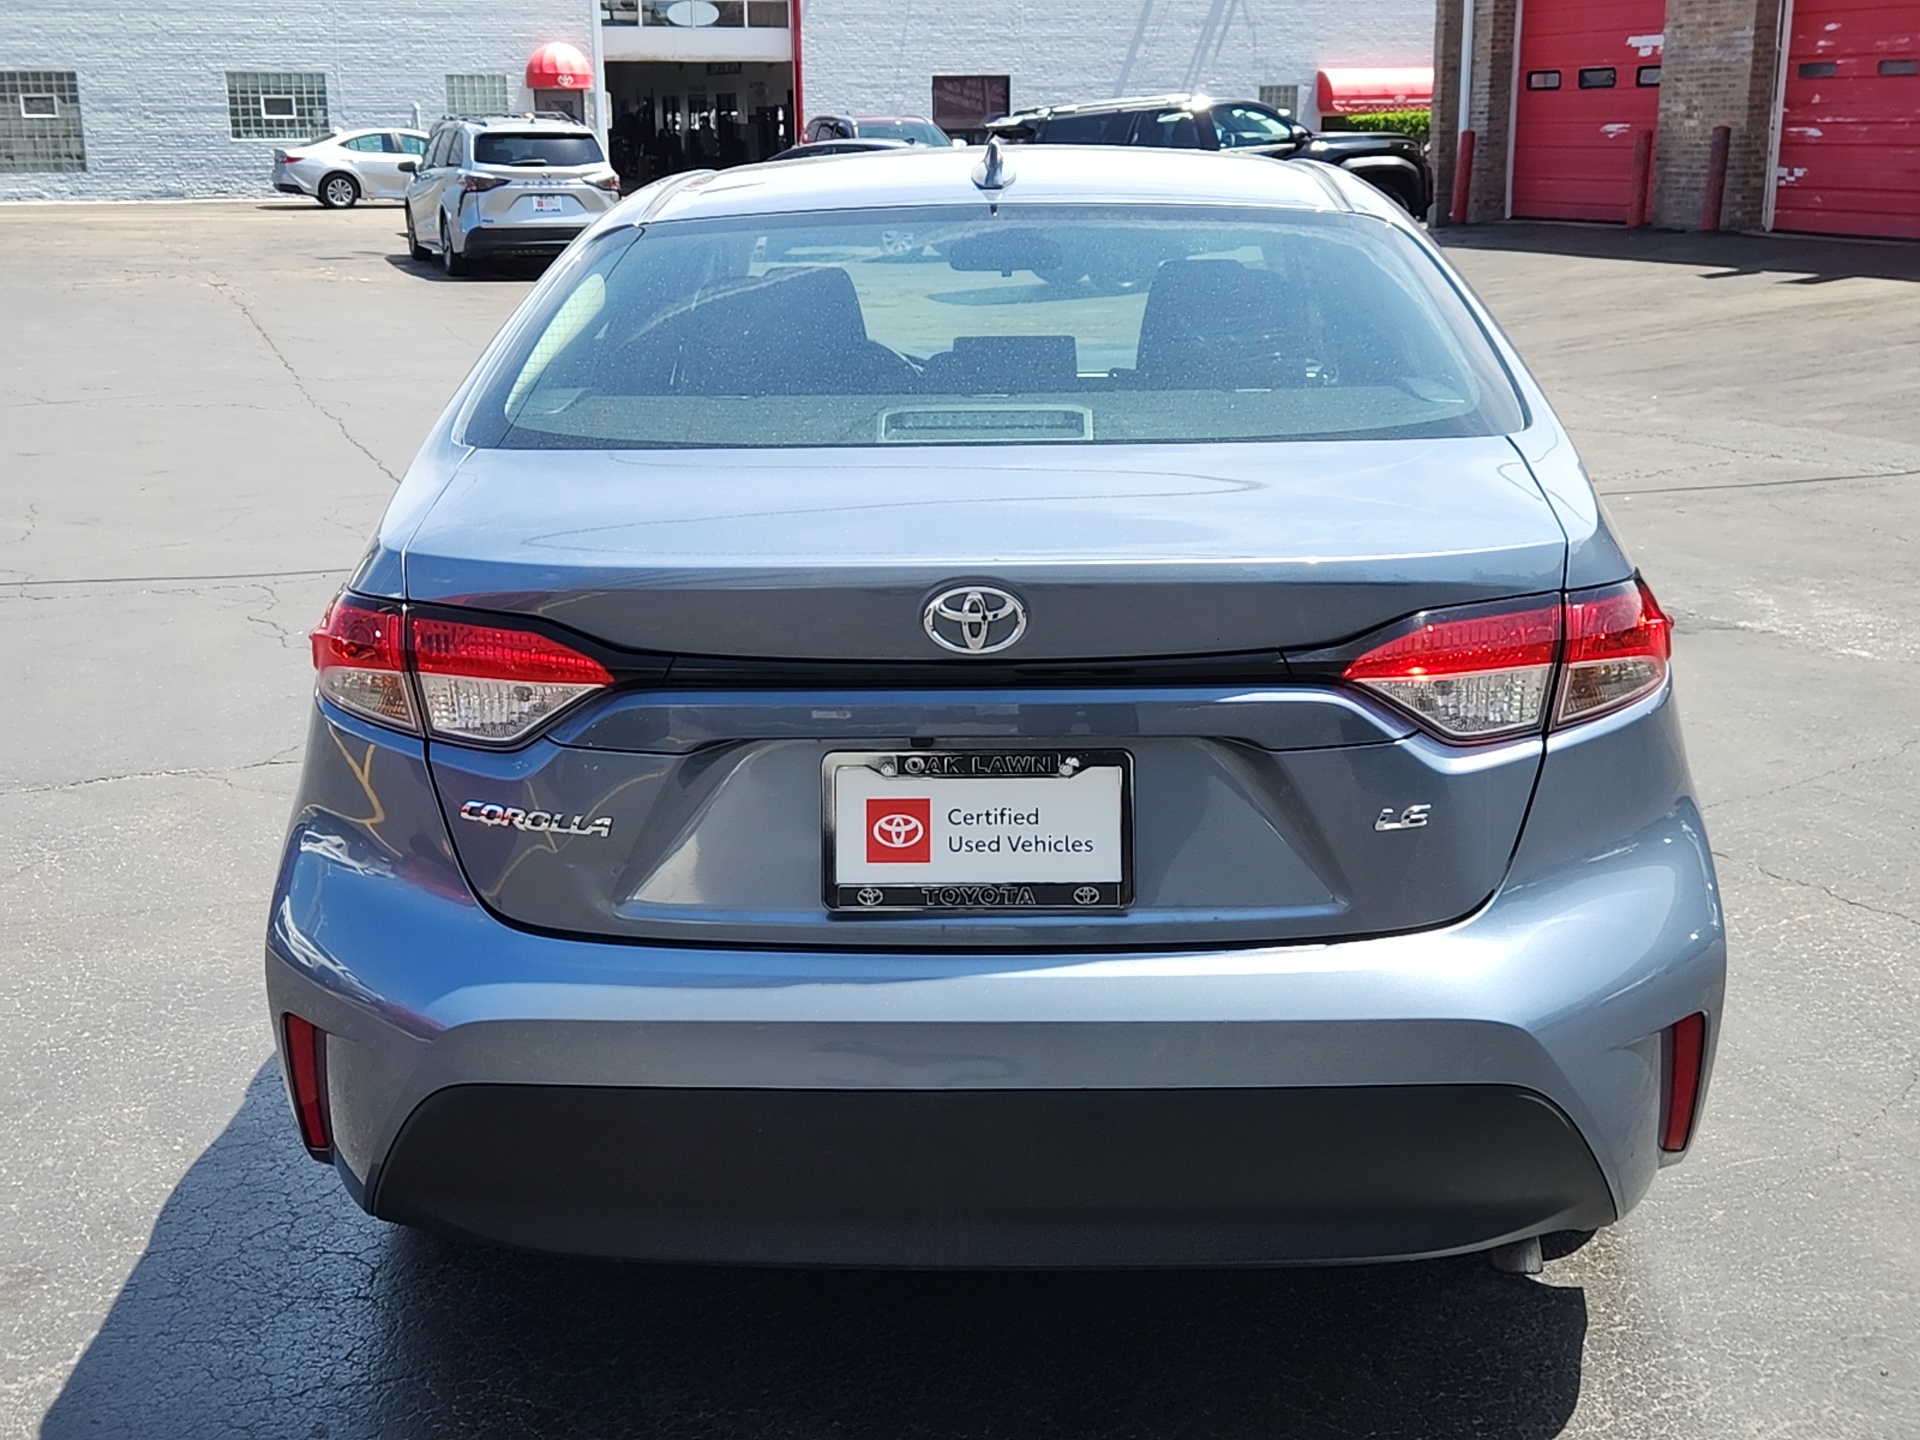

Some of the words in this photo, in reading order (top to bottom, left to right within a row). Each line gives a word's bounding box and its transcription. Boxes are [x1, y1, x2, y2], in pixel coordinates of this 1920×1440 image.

[904, 757, 965, 774] OAK
[971, 756, 1051, 774] LAWN
[460, 801, 613, 837] COROLLA
[947, 807, 1039, 826] Certified
[1375, 804, 1432, 831] LE
[948, 836, 1000, 853] Used
[1007, 835, 1094, 853] Vehicles
[921, 887, 1036, 906] TOYOTA
